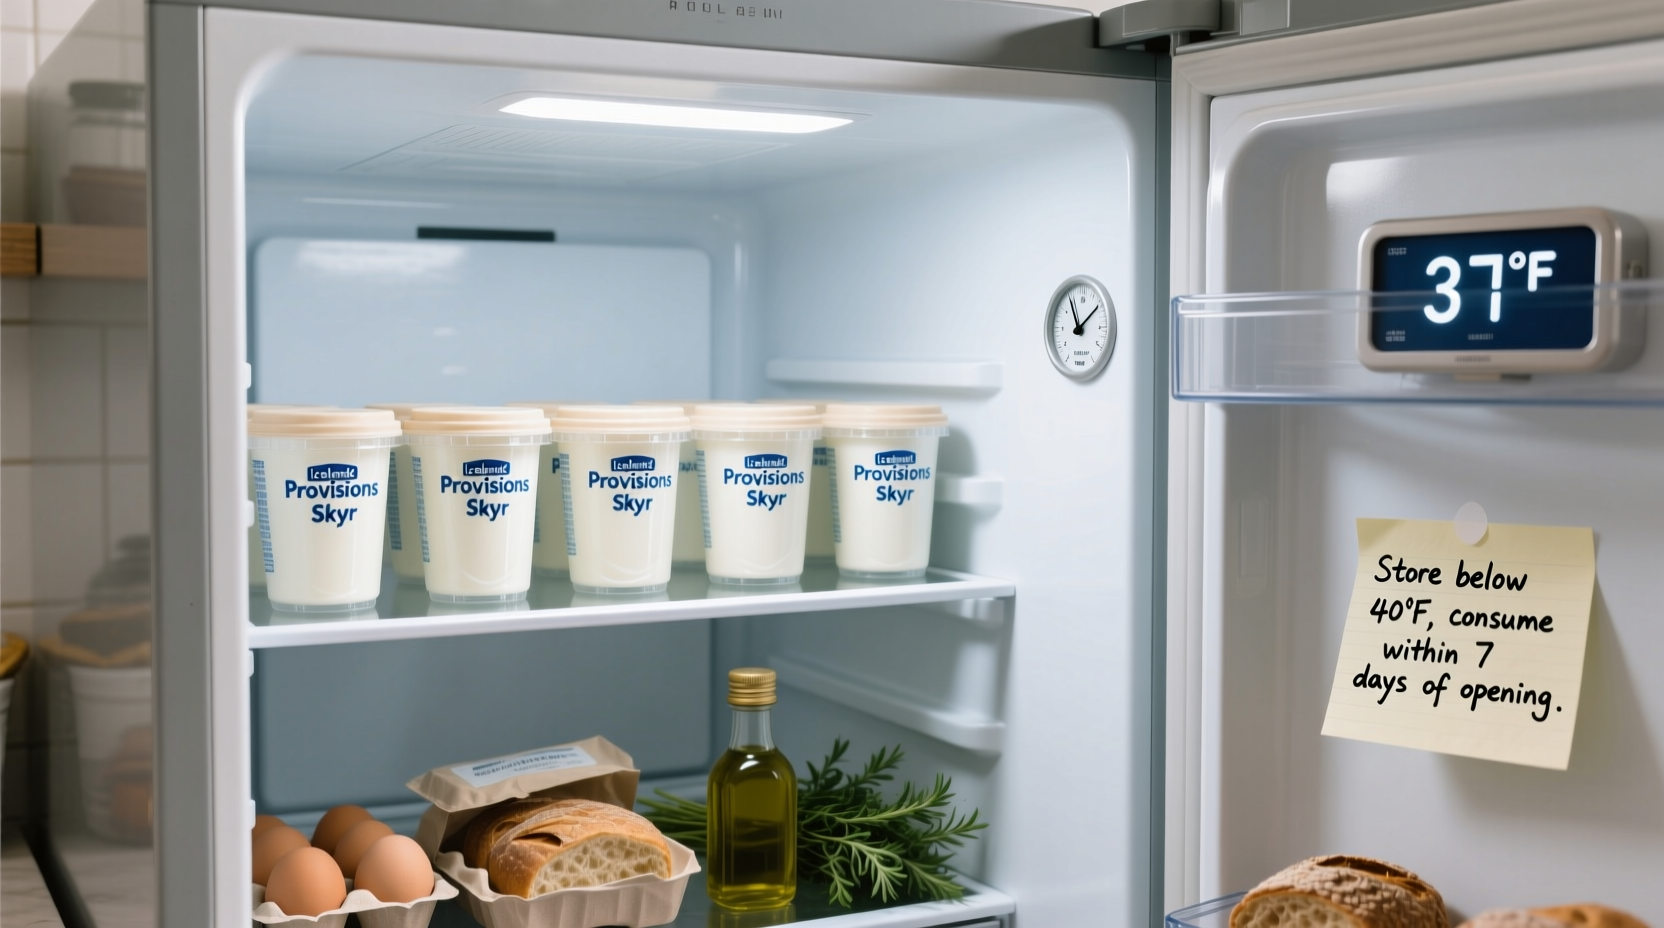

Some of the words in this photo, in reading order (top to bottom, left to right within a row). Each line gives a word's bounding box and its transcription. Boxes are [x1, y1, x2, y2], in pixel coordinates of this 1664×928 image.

[1424, 250, 1557, 324] 37°F
[588, 471, 671, 489] Provisions
[724, 468, 804, 486] Provisions
[854, 465, 930, 481] Provisions
[285, 479, 378, 499] Provisions
[440, 475, 529, 494] Provisions
[876, 485, 914, 506] Skyr
[466, 498, 509, 521] Skyr
[613, 494, 653, 516] Skyr
[746, 490, 787, 511] Skyr
[311, 503, 357, 528] Skyr
[1374, 554, 1442, 585] Store
[1455, 559, 1528, 591] below
[1369, 597, 1434, 632] 40°F,
[1449, 608, 1554, 633] consume
[1383, 637, 1458, 664] within
[1476, 641, 1495, 668] 7
[1352, 663, 1407, 705] days
[1422, 672, 1451, 707] of
[1460, 683, 1562, 722] opening.
